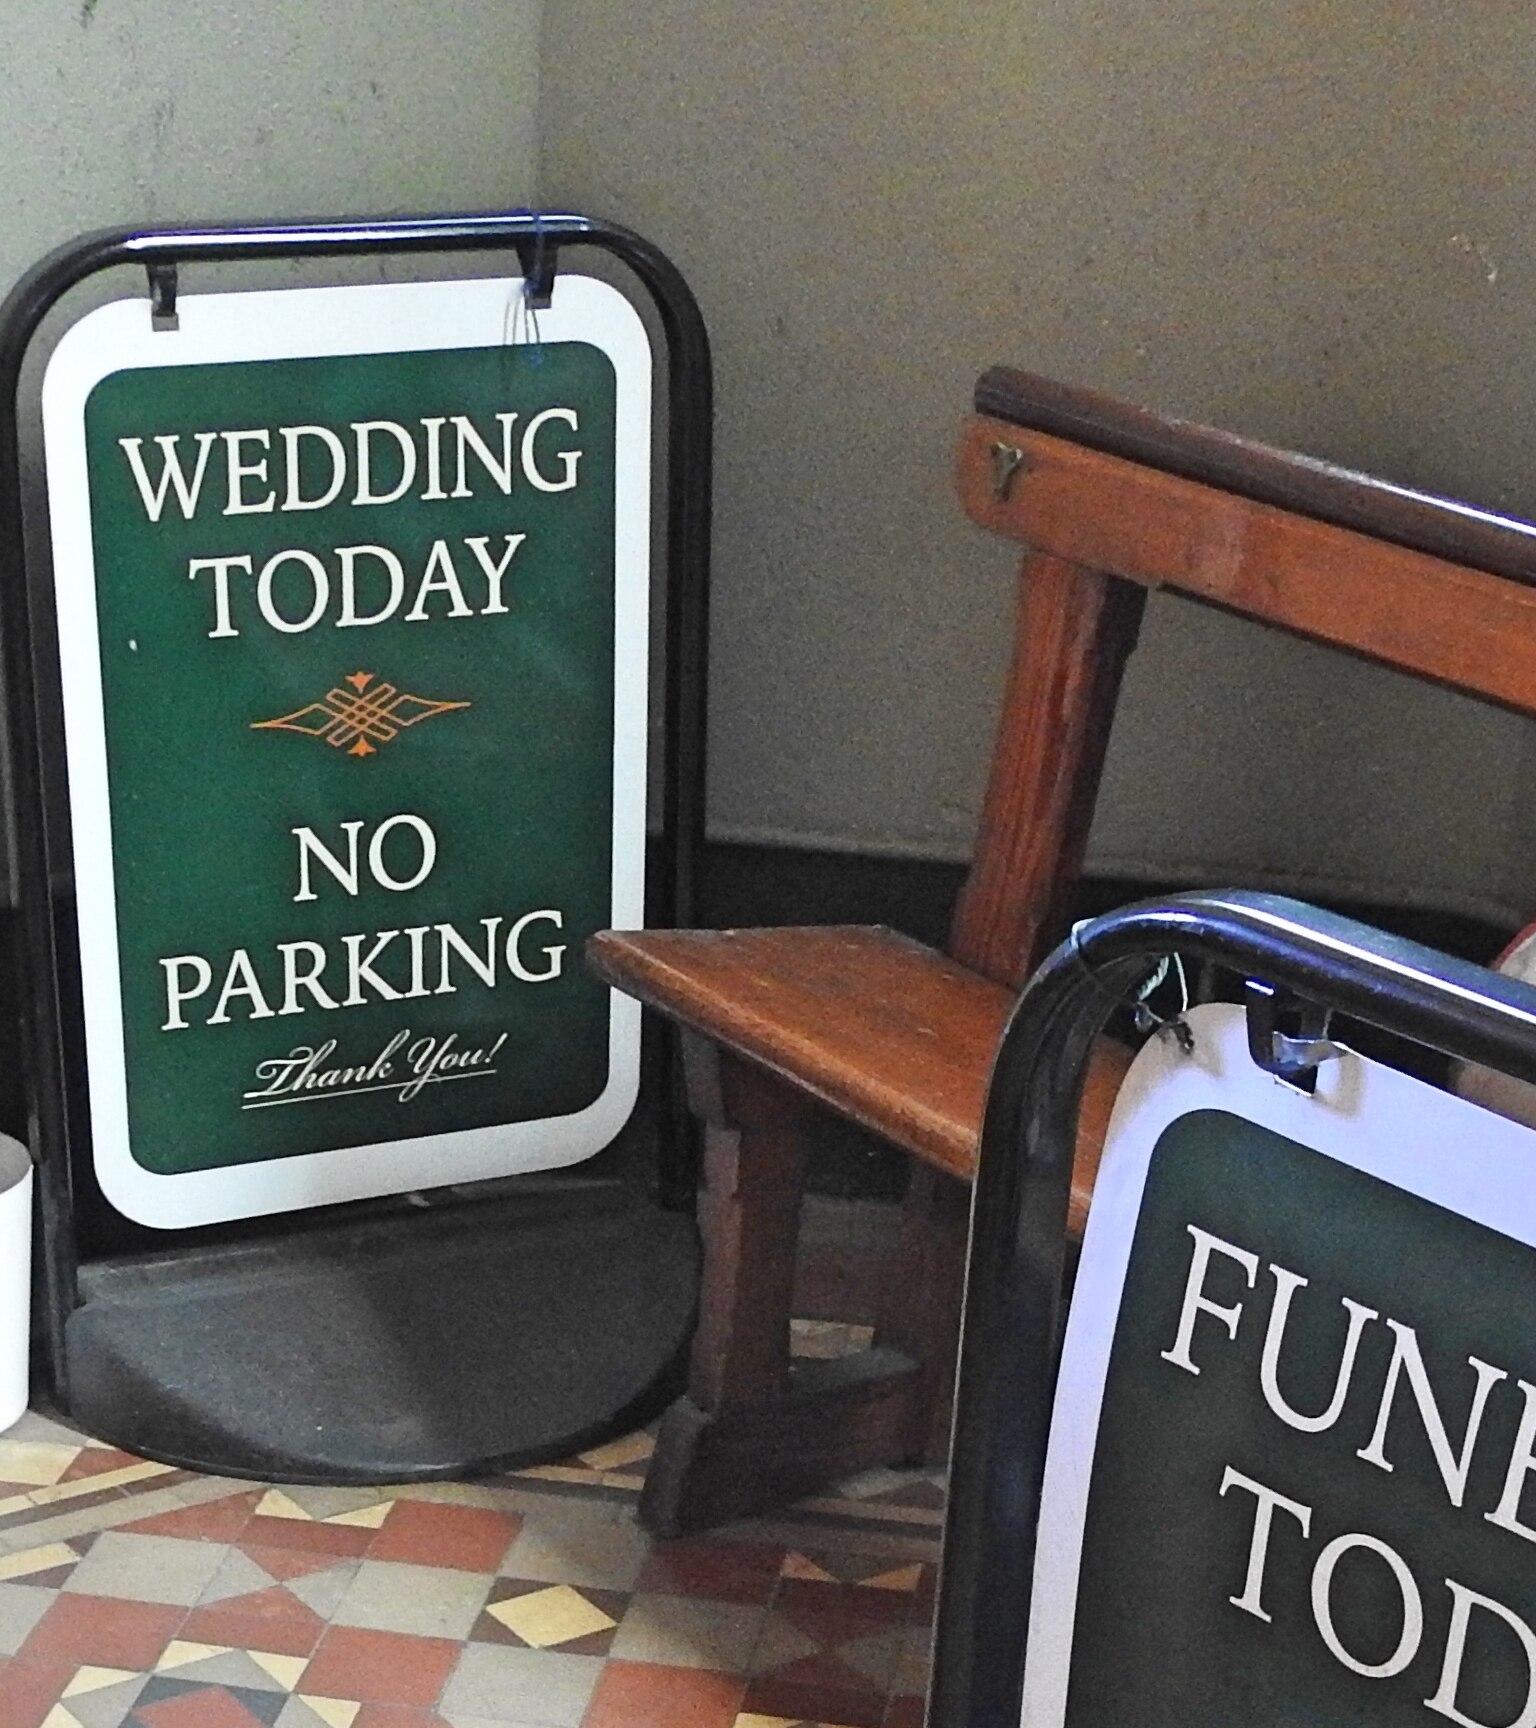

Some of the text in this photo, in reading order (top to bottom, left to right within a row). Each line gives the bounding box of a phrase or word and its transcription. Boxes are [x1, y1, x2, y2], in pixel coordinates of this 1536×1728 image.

[118, 408, 583, 522] WEDDING
[188, 533, 526, 639] TODAY
[292, 813, 437, 902] NO
[160, 909, 566, 1031] PARKING
[243, 1028, 508, 1103] Thank You!
